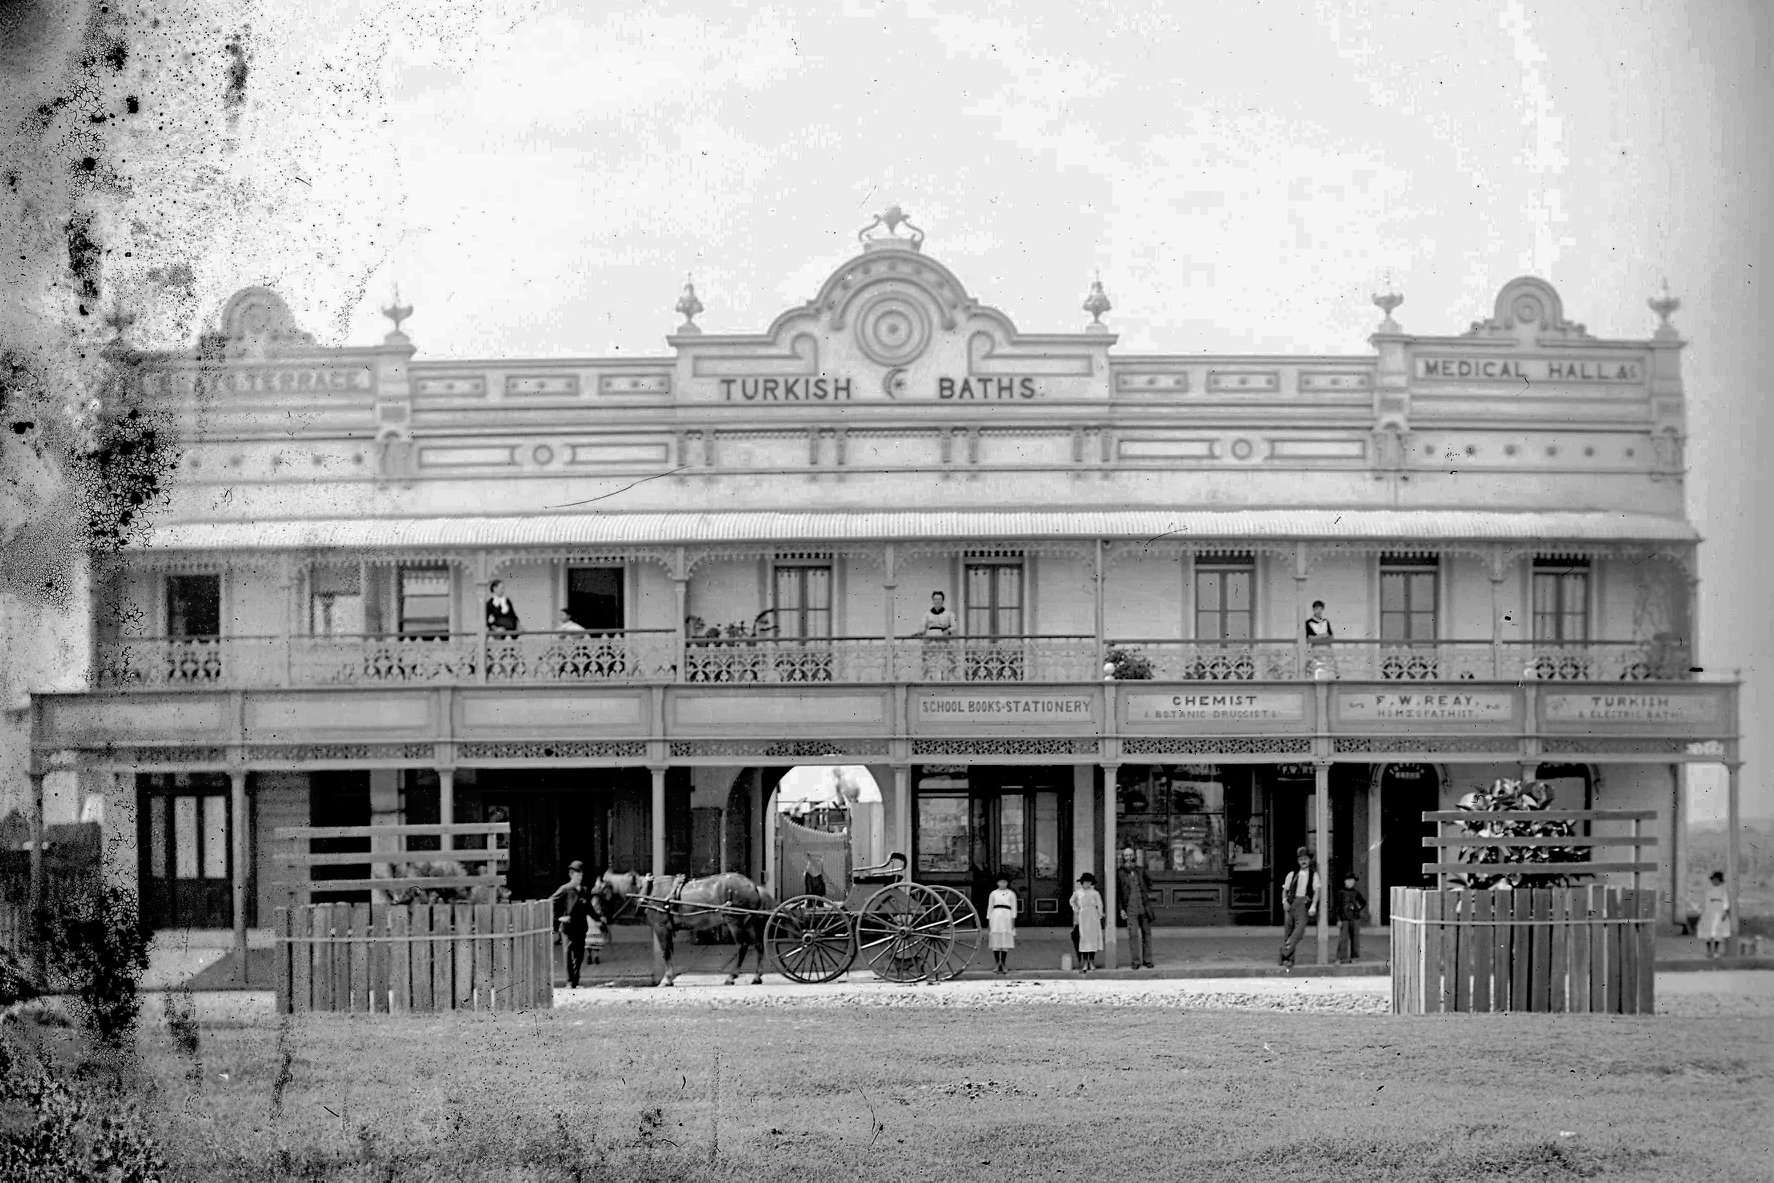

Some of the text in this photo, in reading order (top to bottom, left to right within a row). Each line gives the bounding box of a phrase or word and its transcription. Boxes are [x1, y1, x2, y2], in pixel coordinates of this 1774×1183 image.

[1424, 360, 1526, 378] MEDICAL
[1549, 361, 1610, 380] HALL
[720, 378, 852, 401] TURKISH
[938, 377, 1036, 400] BATHS
[922, 700, 965, 713] SCHOOL
[1172, 695, 1257, 706] CHEMIST
[1591, 696, 1670, 708] TURKISH
